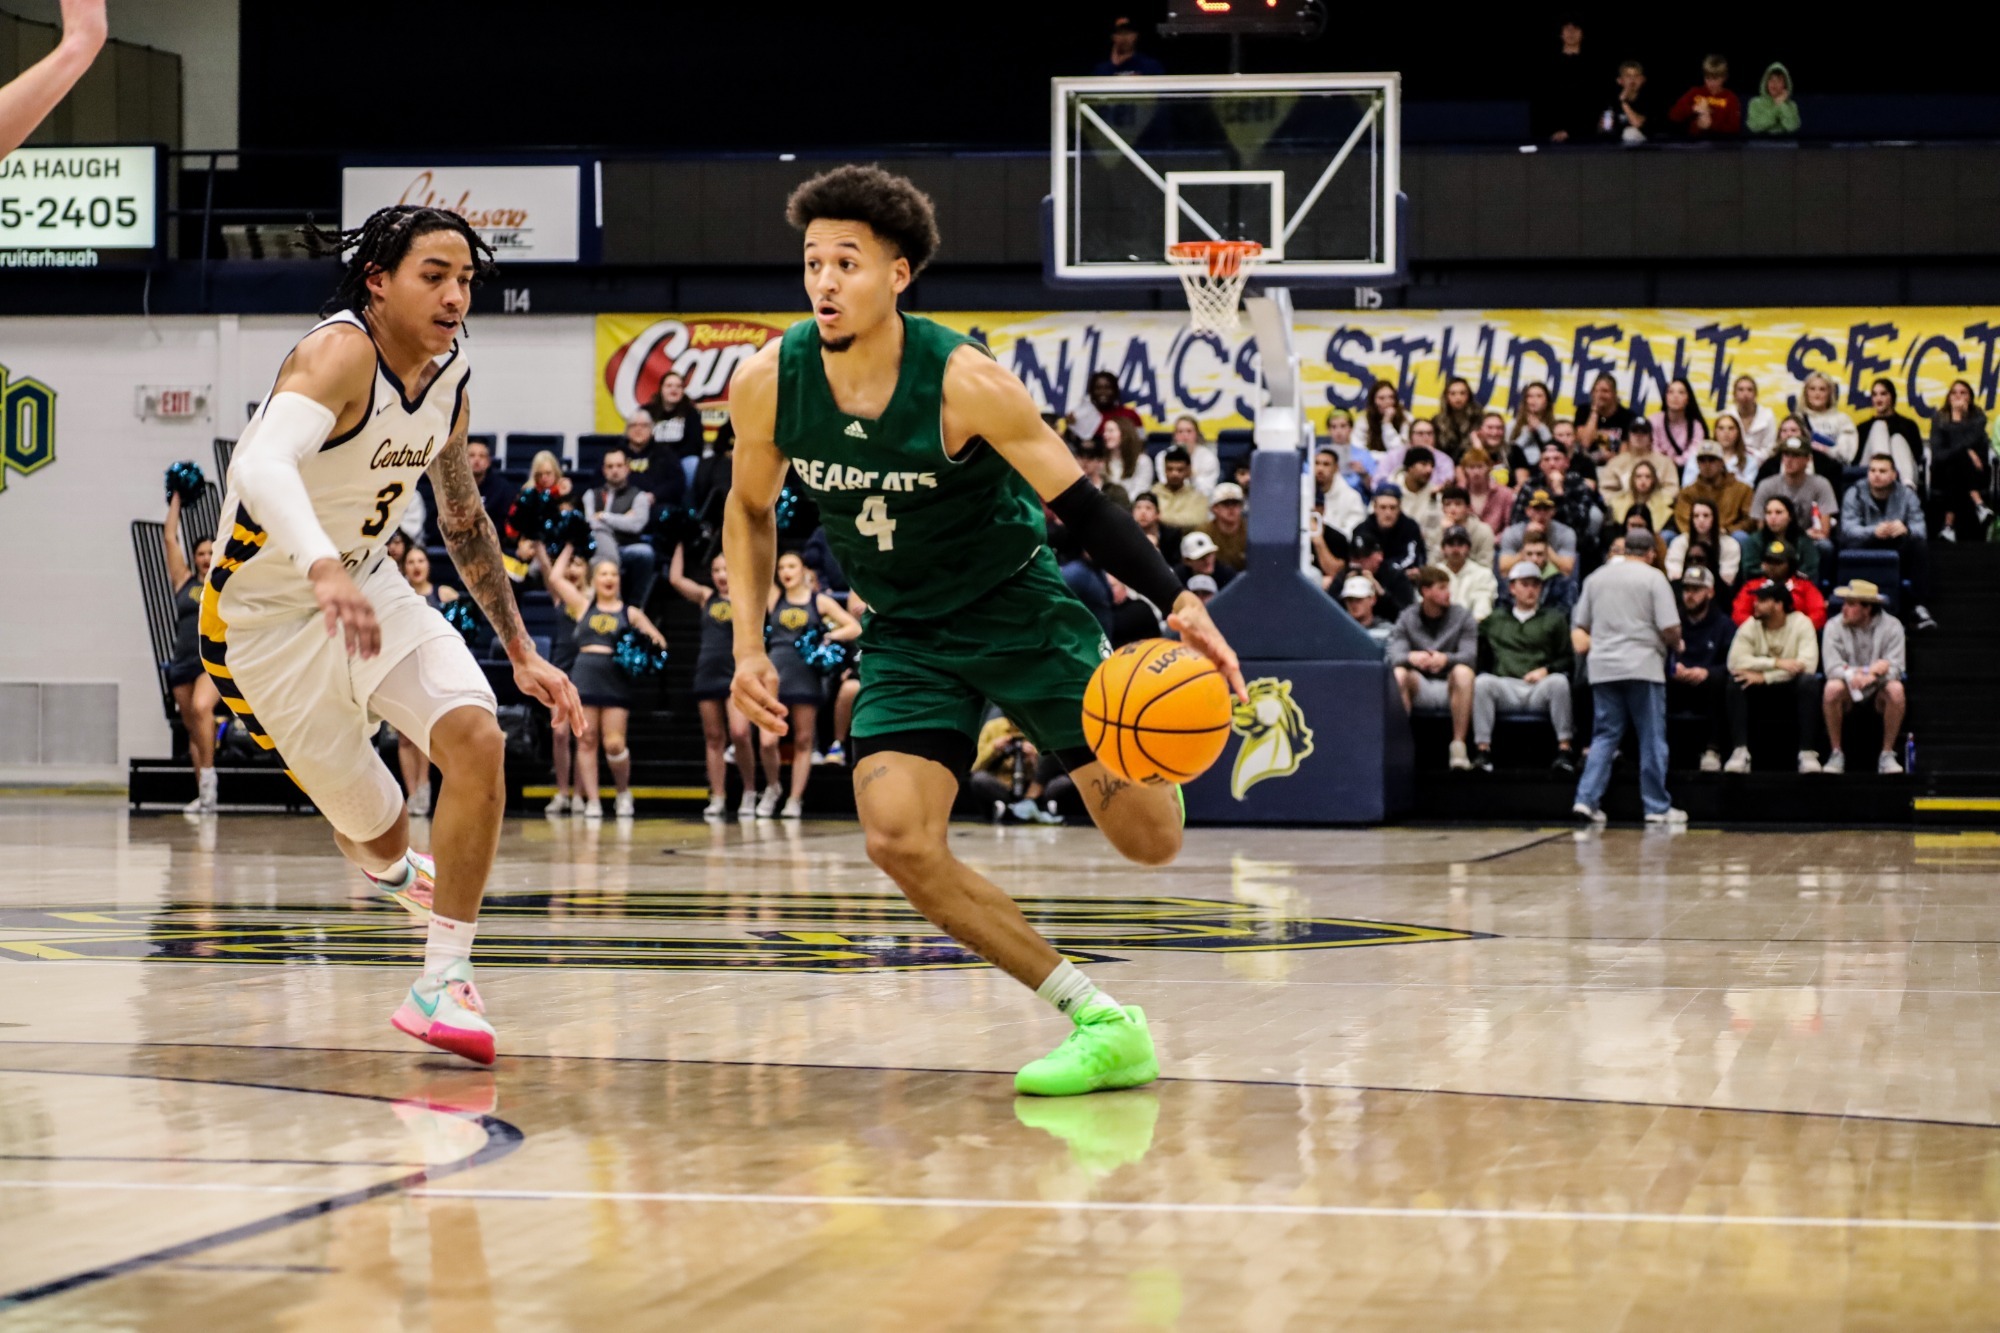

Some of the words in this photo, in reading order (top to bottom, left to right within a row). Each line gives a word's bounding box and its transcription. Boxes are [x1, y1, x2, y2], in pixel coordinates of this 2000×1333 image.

[33, 158, 121, 178] HAUGH
[1, 197, 137, 228] 5-2405
[504, 288, 530, 311] 114
[691, 324, 767, 347] Raising
[1326, 323, 1750, 417] STUDENT
[162, 391, 192, 415] EXIT
[370, 435, 434, 470] Central
[361, 481, 404, 538] 3
[855, 495, 897, 551] 4
